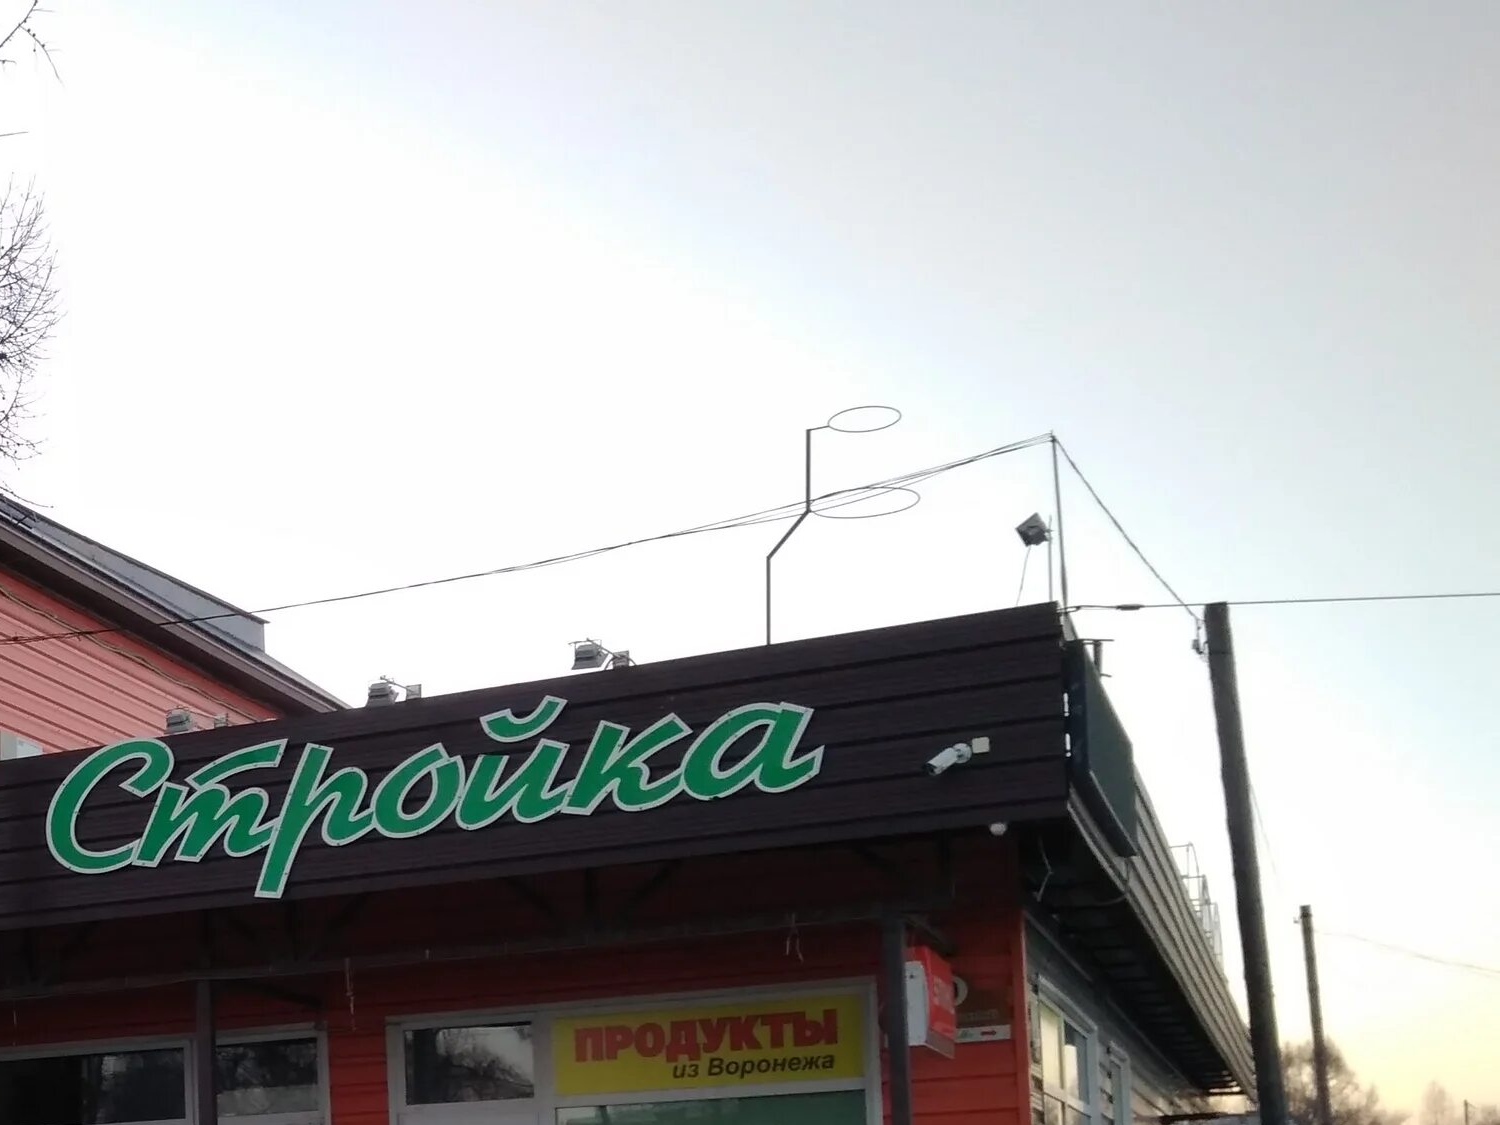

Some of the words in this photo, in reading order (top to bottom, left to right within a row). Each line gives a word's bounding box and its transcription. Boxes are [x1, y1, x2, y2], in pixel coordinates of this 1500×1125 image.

[47, 695, 825, 898] Стройка
[574, 1009, 838, 1062] ПРОДУКТЫ
[672, 1063, 699, 1079] из
[707, 1054, 836, 1080] Воронежа
